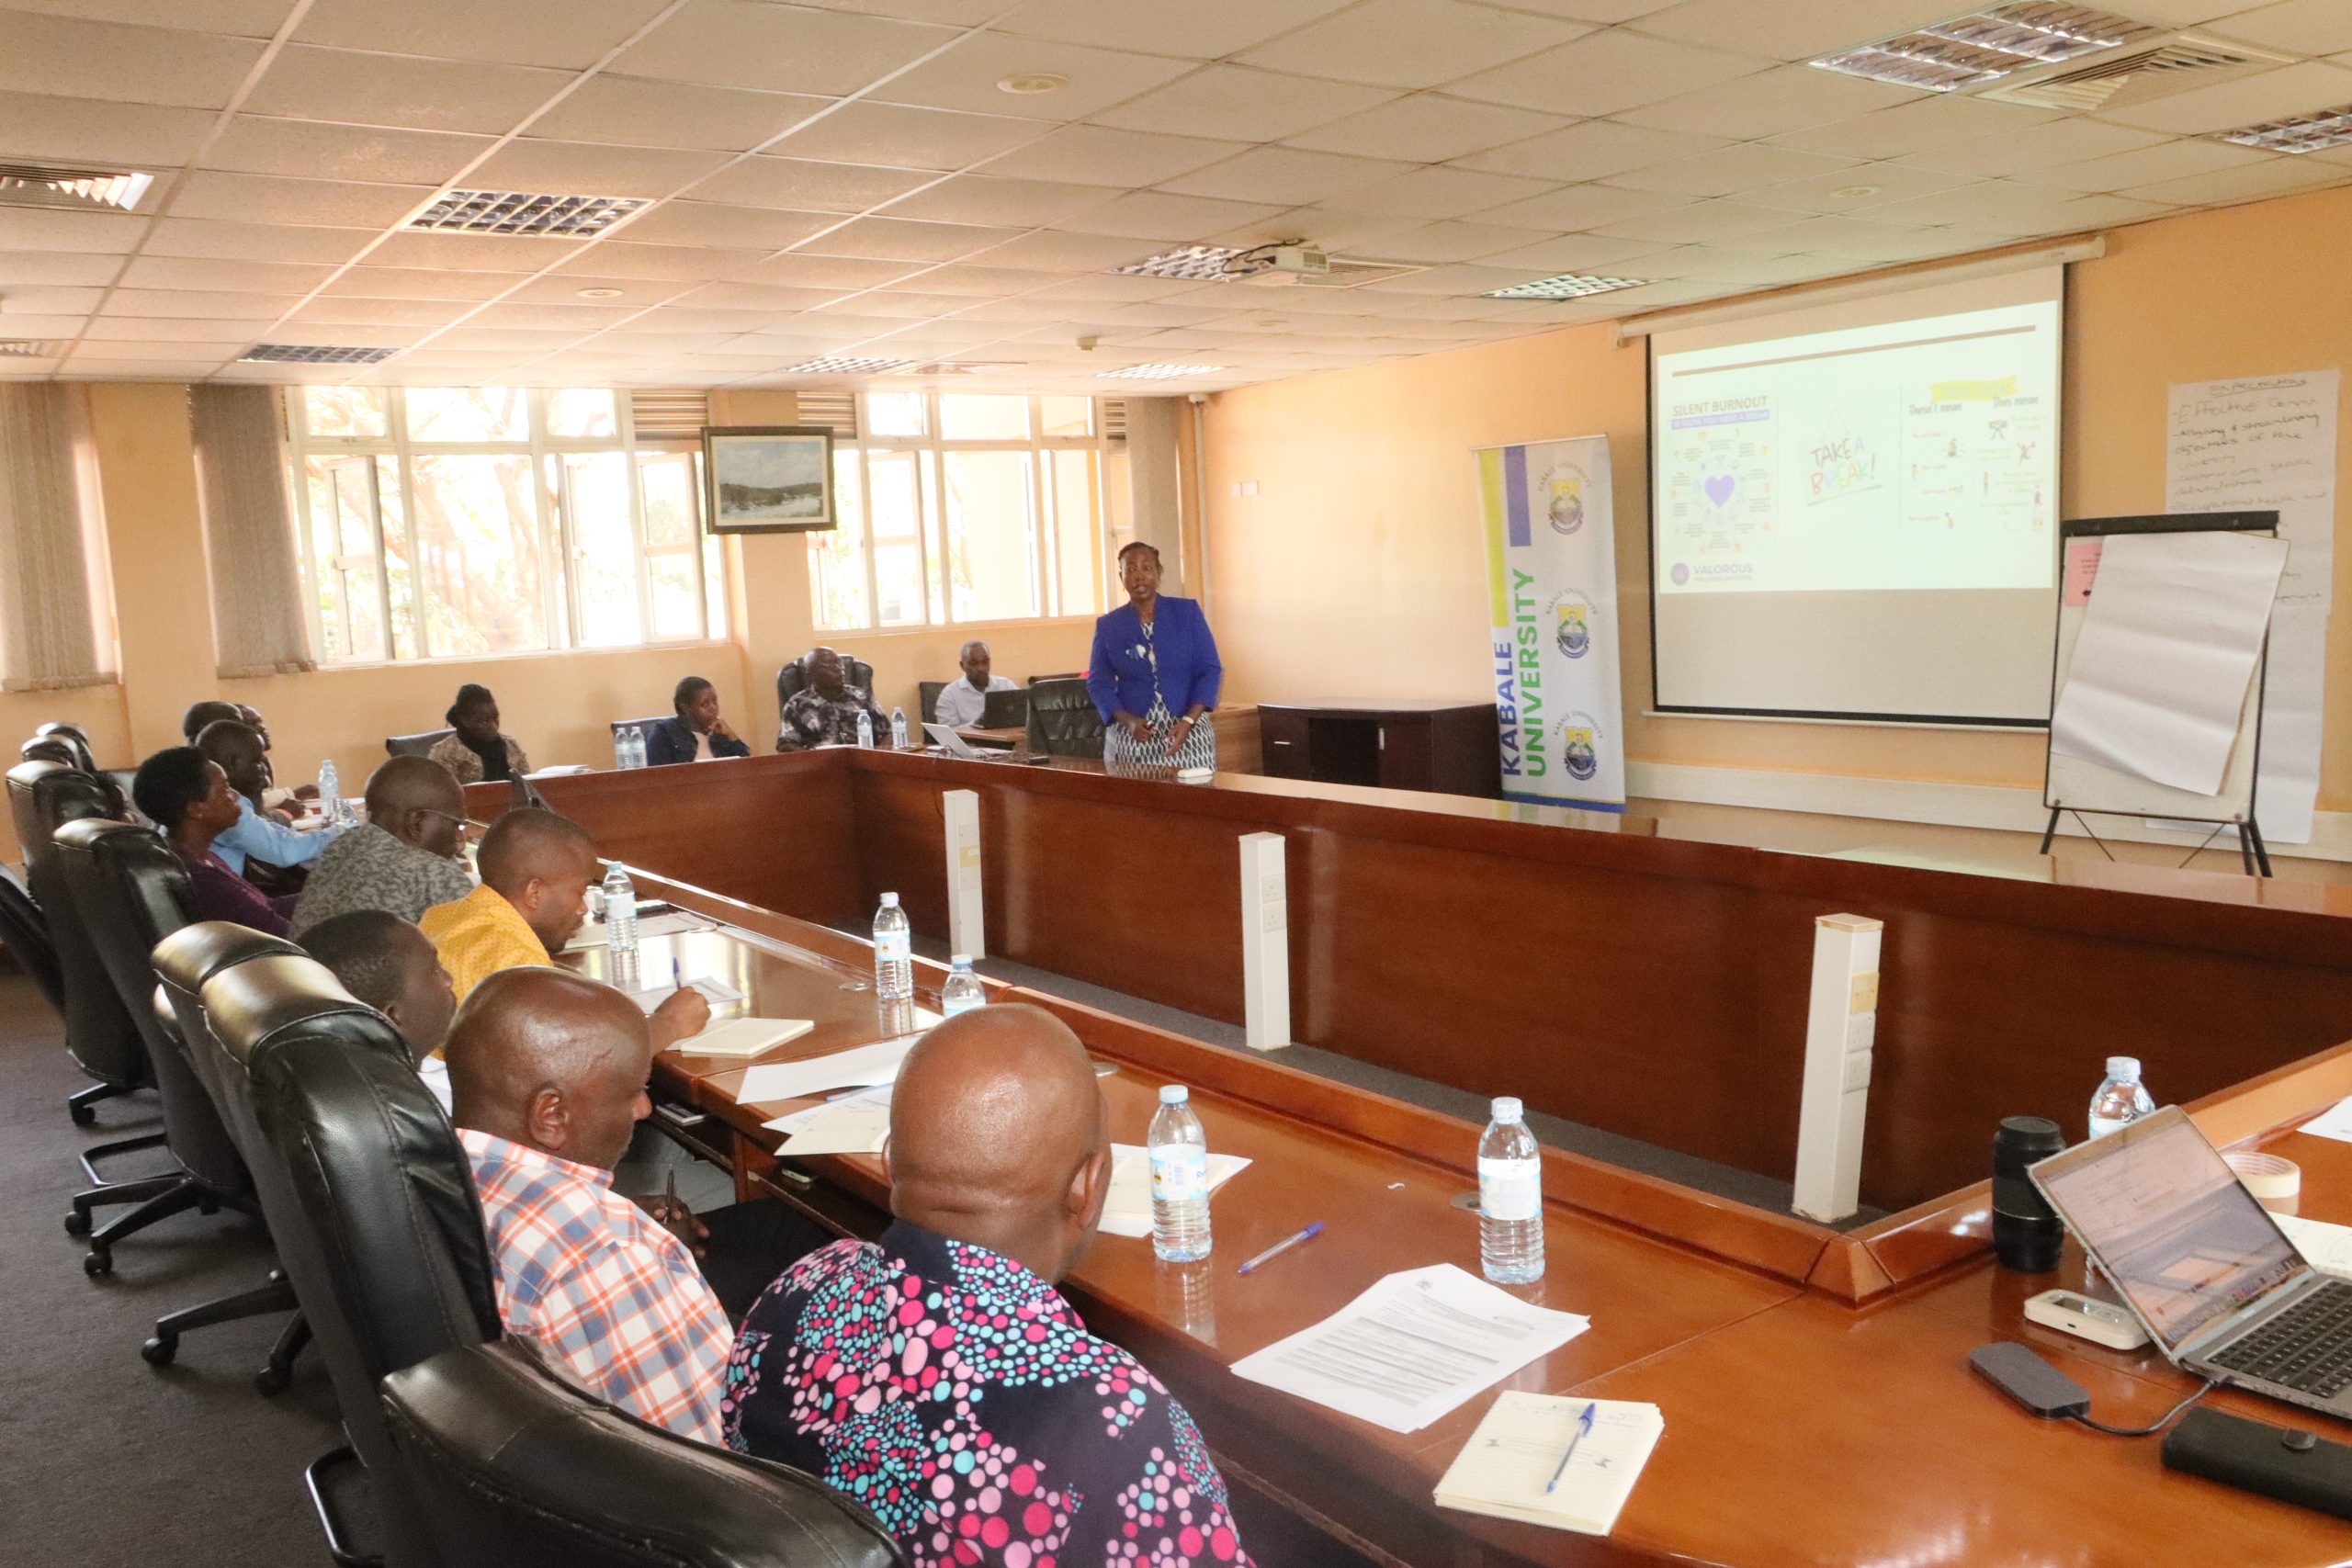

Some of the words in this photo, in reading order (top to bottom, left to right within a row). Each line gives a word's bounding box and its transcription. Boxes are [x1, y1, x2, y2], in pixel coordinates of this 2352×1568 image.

[1673, 402, 1709, 416] SILENT
[1712, 395, 1768, 412] BURNOUT
[1703, 416, 1718, 425] YOU
[1810, 437, 1852, 468] TAKE
[1855, 436, 1865, 456] A
[1811, 453, 1876, 495] BREAK!
[1692, 563, 1754, 574] VALOROUS
[1545, 590, 1564, 615] KABALE
[1564, 587, 1600, 615] UNIVERSITY
[1512, 568, 1547, 777] UNIVERSITY
[1494, 641, 1521, 777] KABALE
[1553, 712, 1570, 736] KABALE
[1571, 710, 1604, 739] UNIVERSITY
